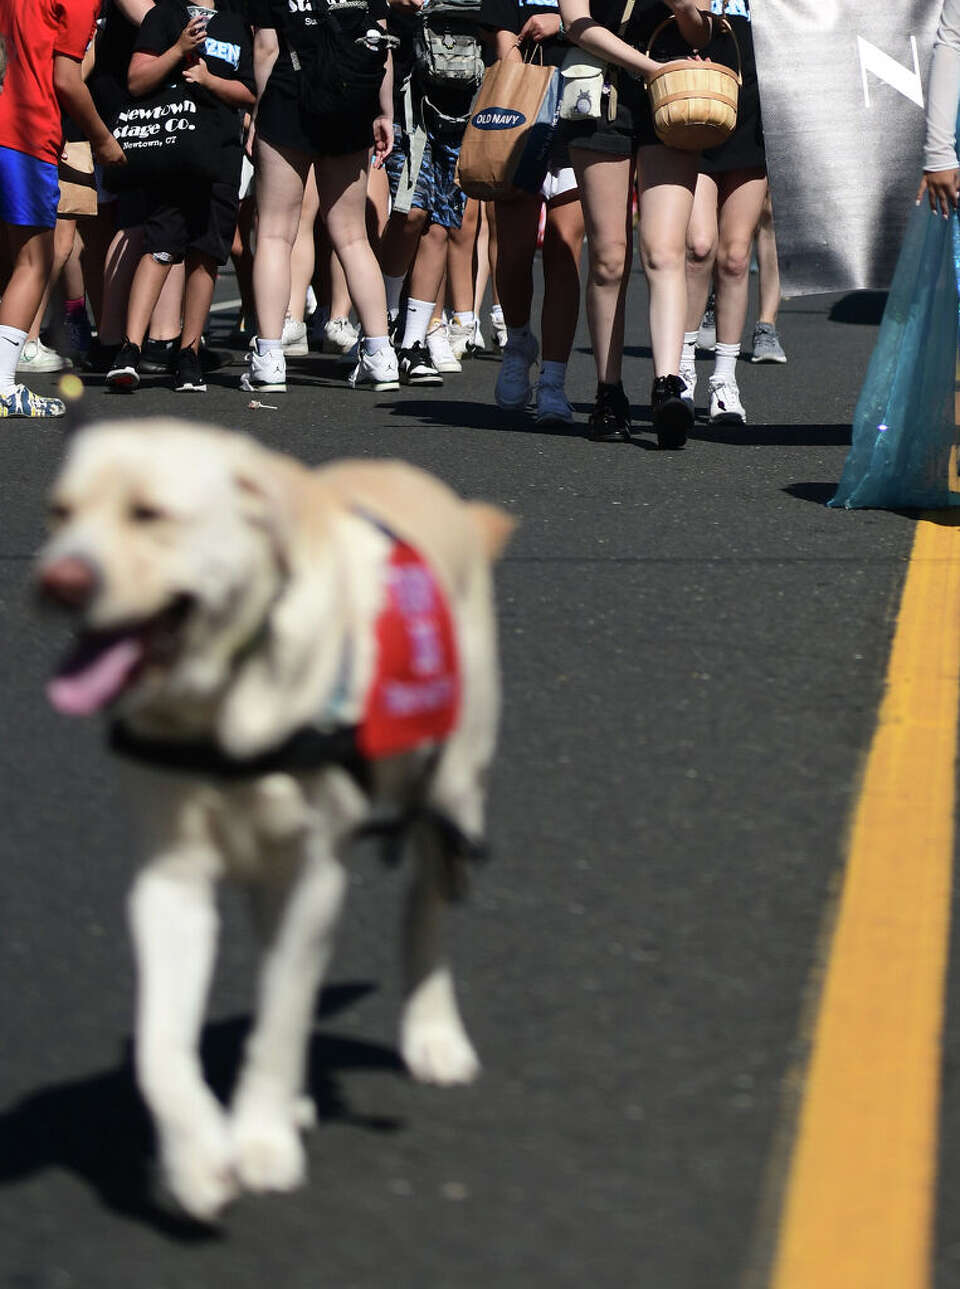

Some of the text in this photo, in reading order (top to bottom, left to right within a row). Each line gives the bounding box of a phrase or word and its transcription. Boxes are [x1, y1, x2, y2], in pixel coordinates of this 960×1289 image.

[117, 100, 197, 123] Newtown
[165, 118, 196, 133] Co.
[476, 114, 519, 125] OLD NAVY
